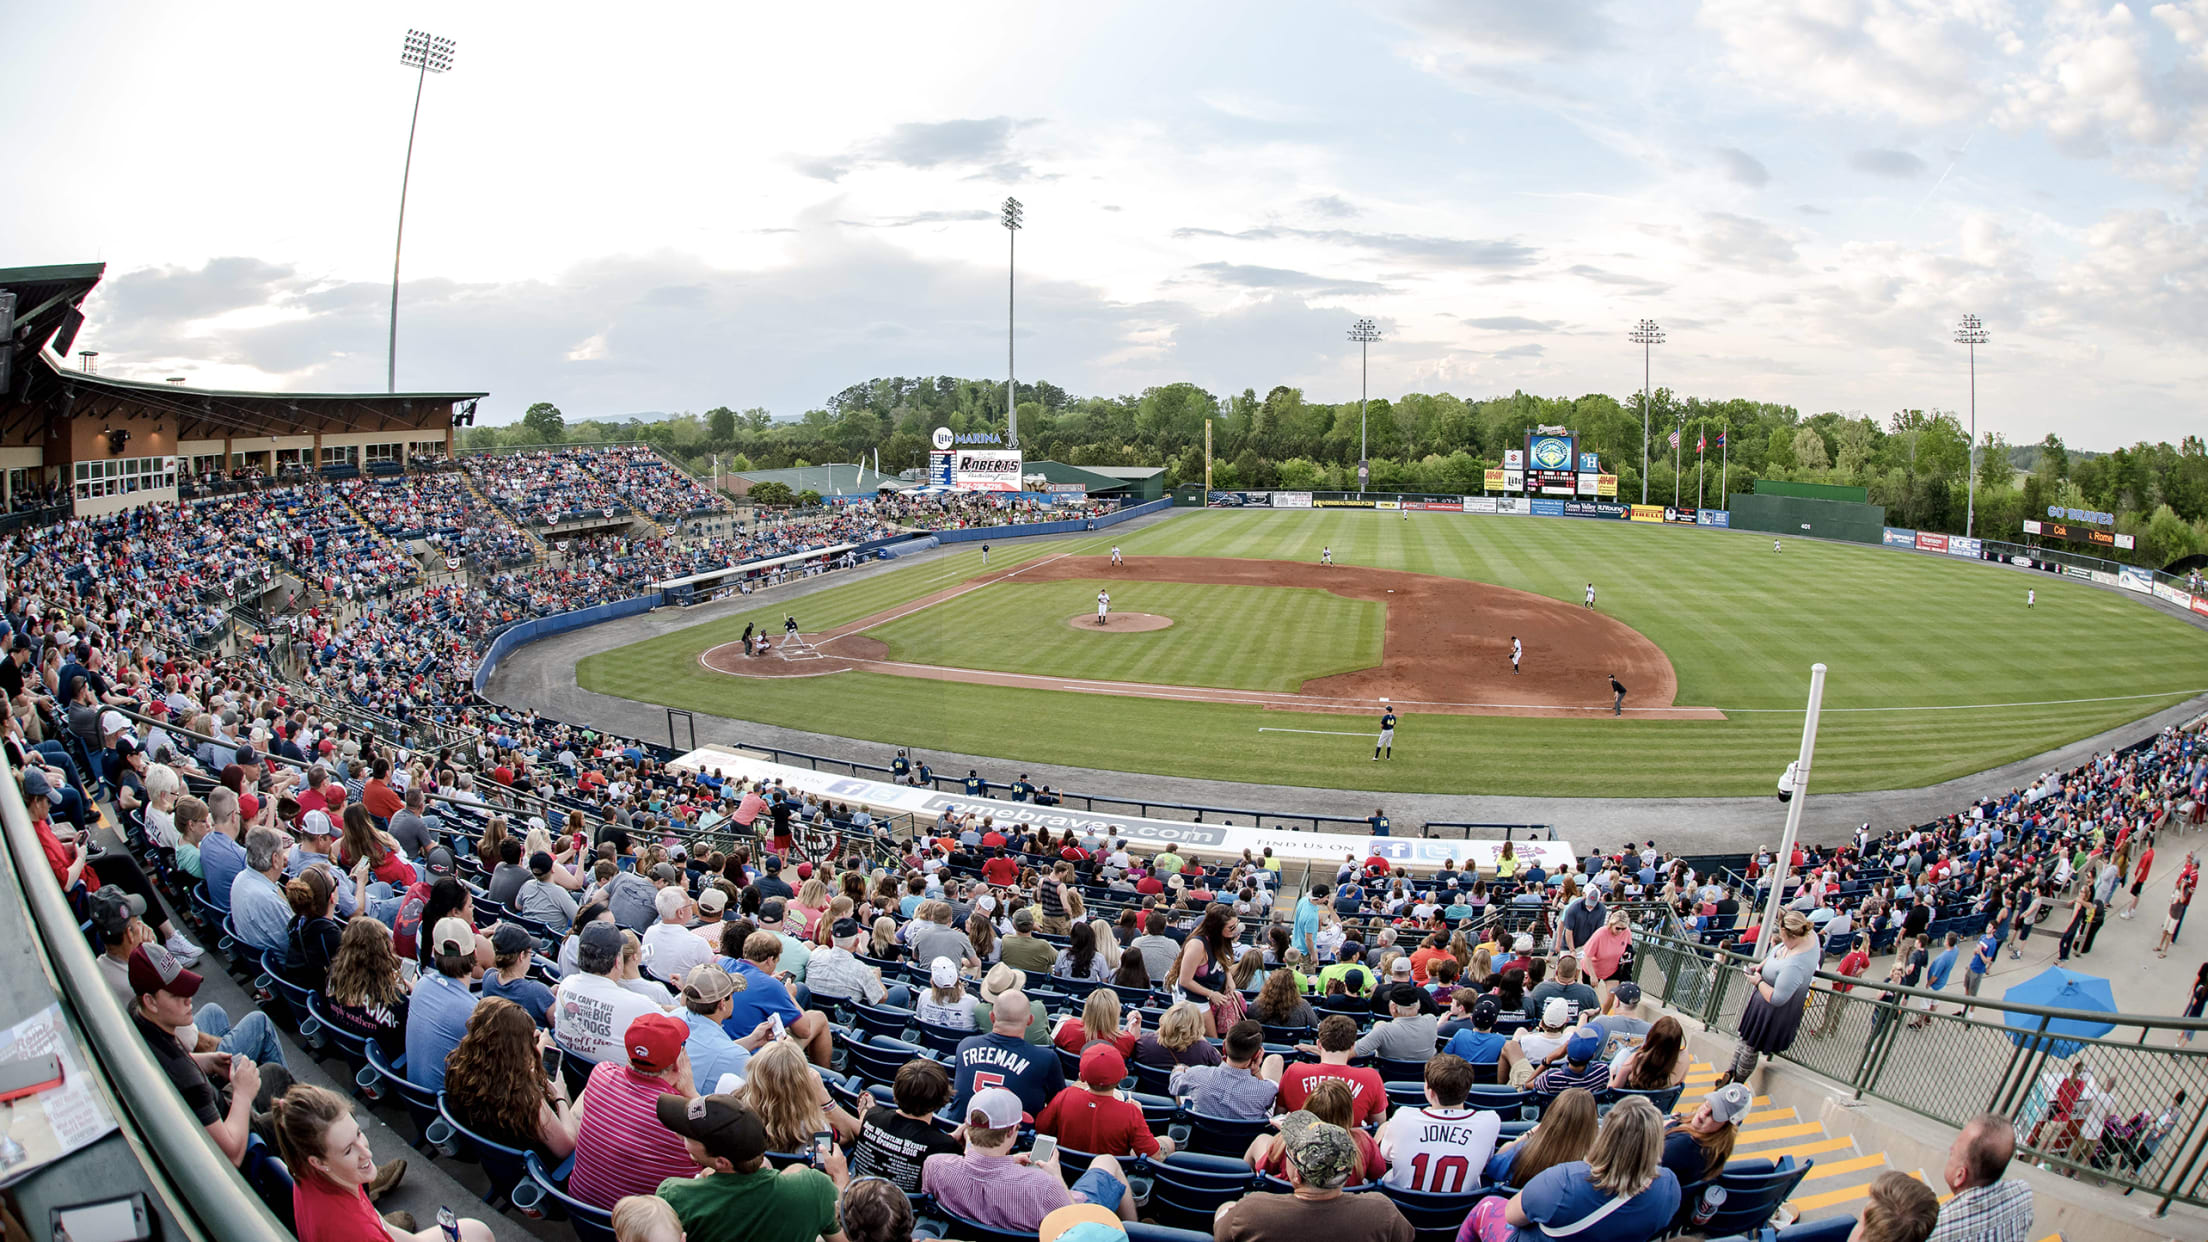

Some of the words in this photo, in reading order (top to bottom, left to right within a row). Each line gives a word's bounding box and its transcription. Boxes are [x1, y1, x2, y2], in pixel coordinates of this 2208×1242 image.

[938, 433, 953, 445] Lite
[955, 432, 1002, 444] MARINA
[958, 455, 1020, 473] ROBERTS
[1508, 476, 1523, 487] Lite
[1631, 508, 1663, 518] PIRELLI
[2047, 505, 2065, 519] GO
[2068, 508, 2114, 525] BRAVES
[2094, 531, 2113, 544] Rome
[933, 796, 1214, 844] romebraves.com
[1256, 839, 1297, 848] FIND
[1329, 844, 1355, 852] ON
[562, 989, 577, 1001] YOU
[578, 994, 600, 1008] CAN'T
[600, 1001, 615, 1013] HIT
[592, 1007, 612, 1025] BIG
[583, 1018, 612, 1037] DOGS
[962, 1046, 1031, 1076] FREEMAN
[973, 1070, 1010, 1095] 5
[1419, 1124, 1473, 1146] JONES
[1410, 1152, 1470, 1193] 10
